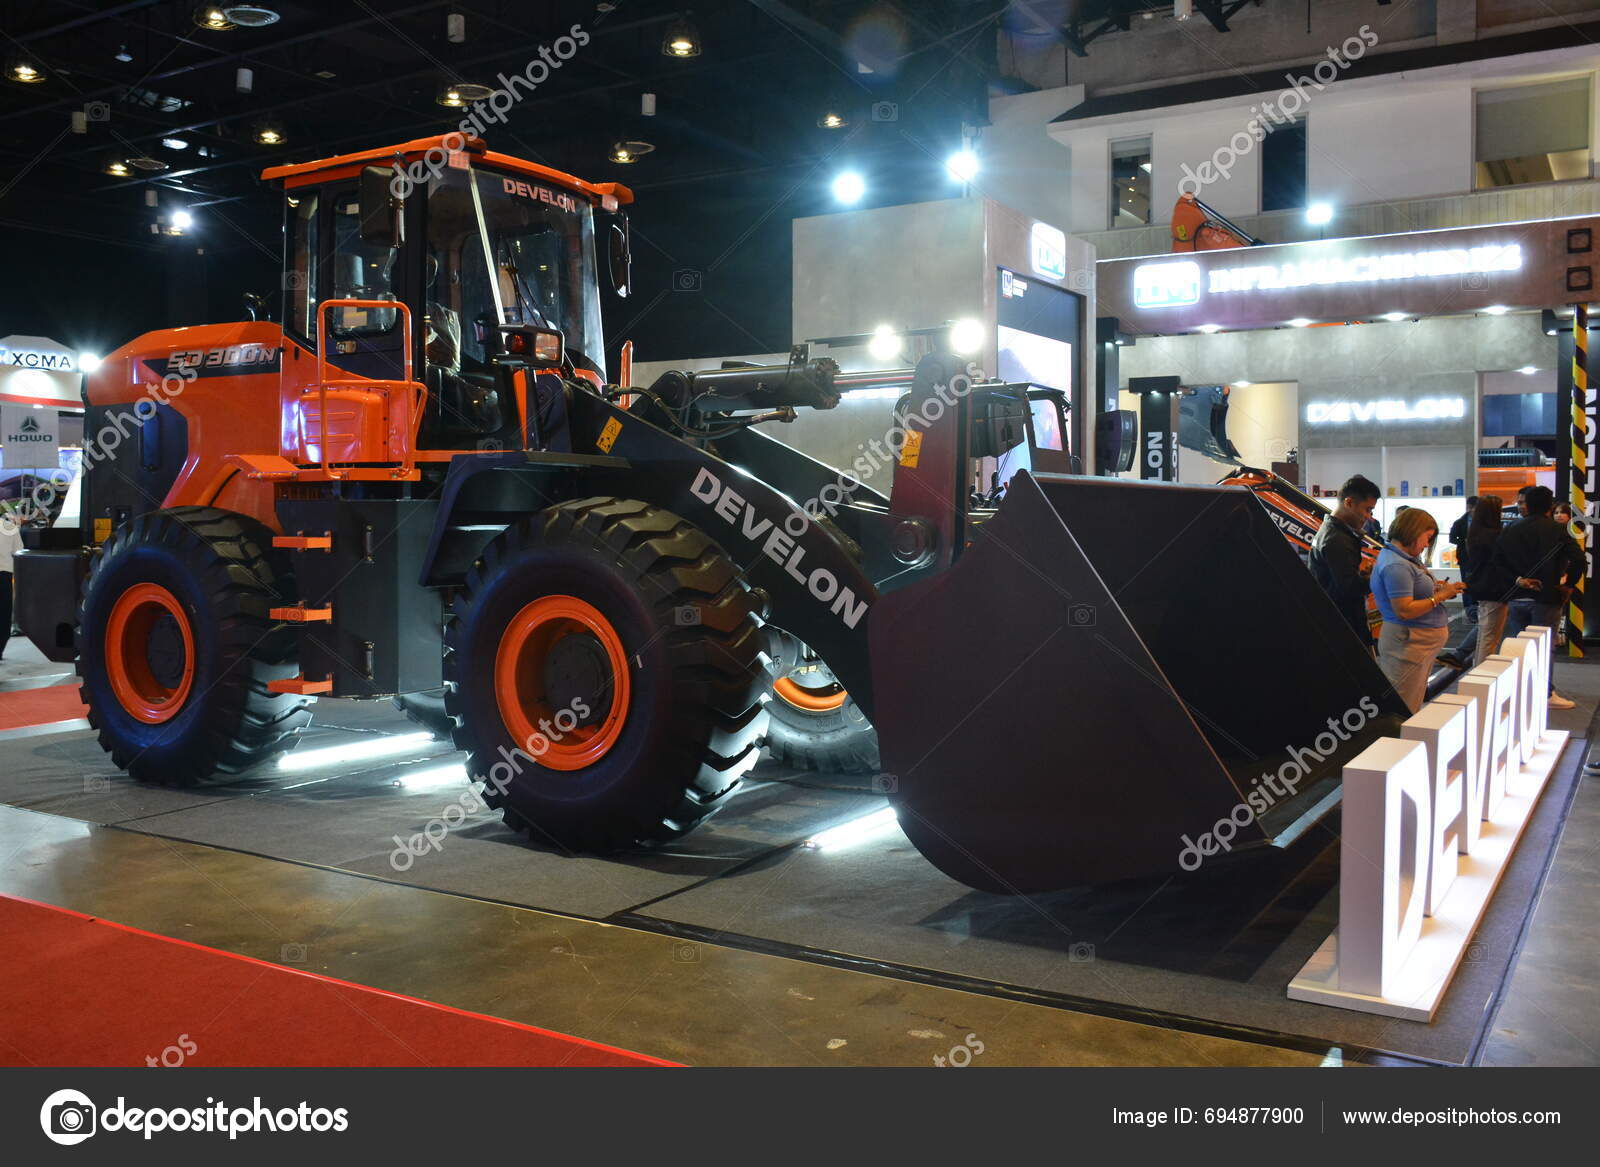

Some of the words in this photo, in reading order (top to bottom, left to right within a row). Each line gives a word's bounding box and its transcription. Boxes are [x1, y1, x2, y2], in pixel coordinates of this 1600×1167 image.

[503, 178, 576, 213] DEVELON
[12, 352, 71, 369] XGMA
[1307, 398, 1465, 423] DEVELON
[8, 434, 53, 442] HOWO
[1266, 507, 1315, 543] EVELO
[689, 466, 869, 630] DEVELON
